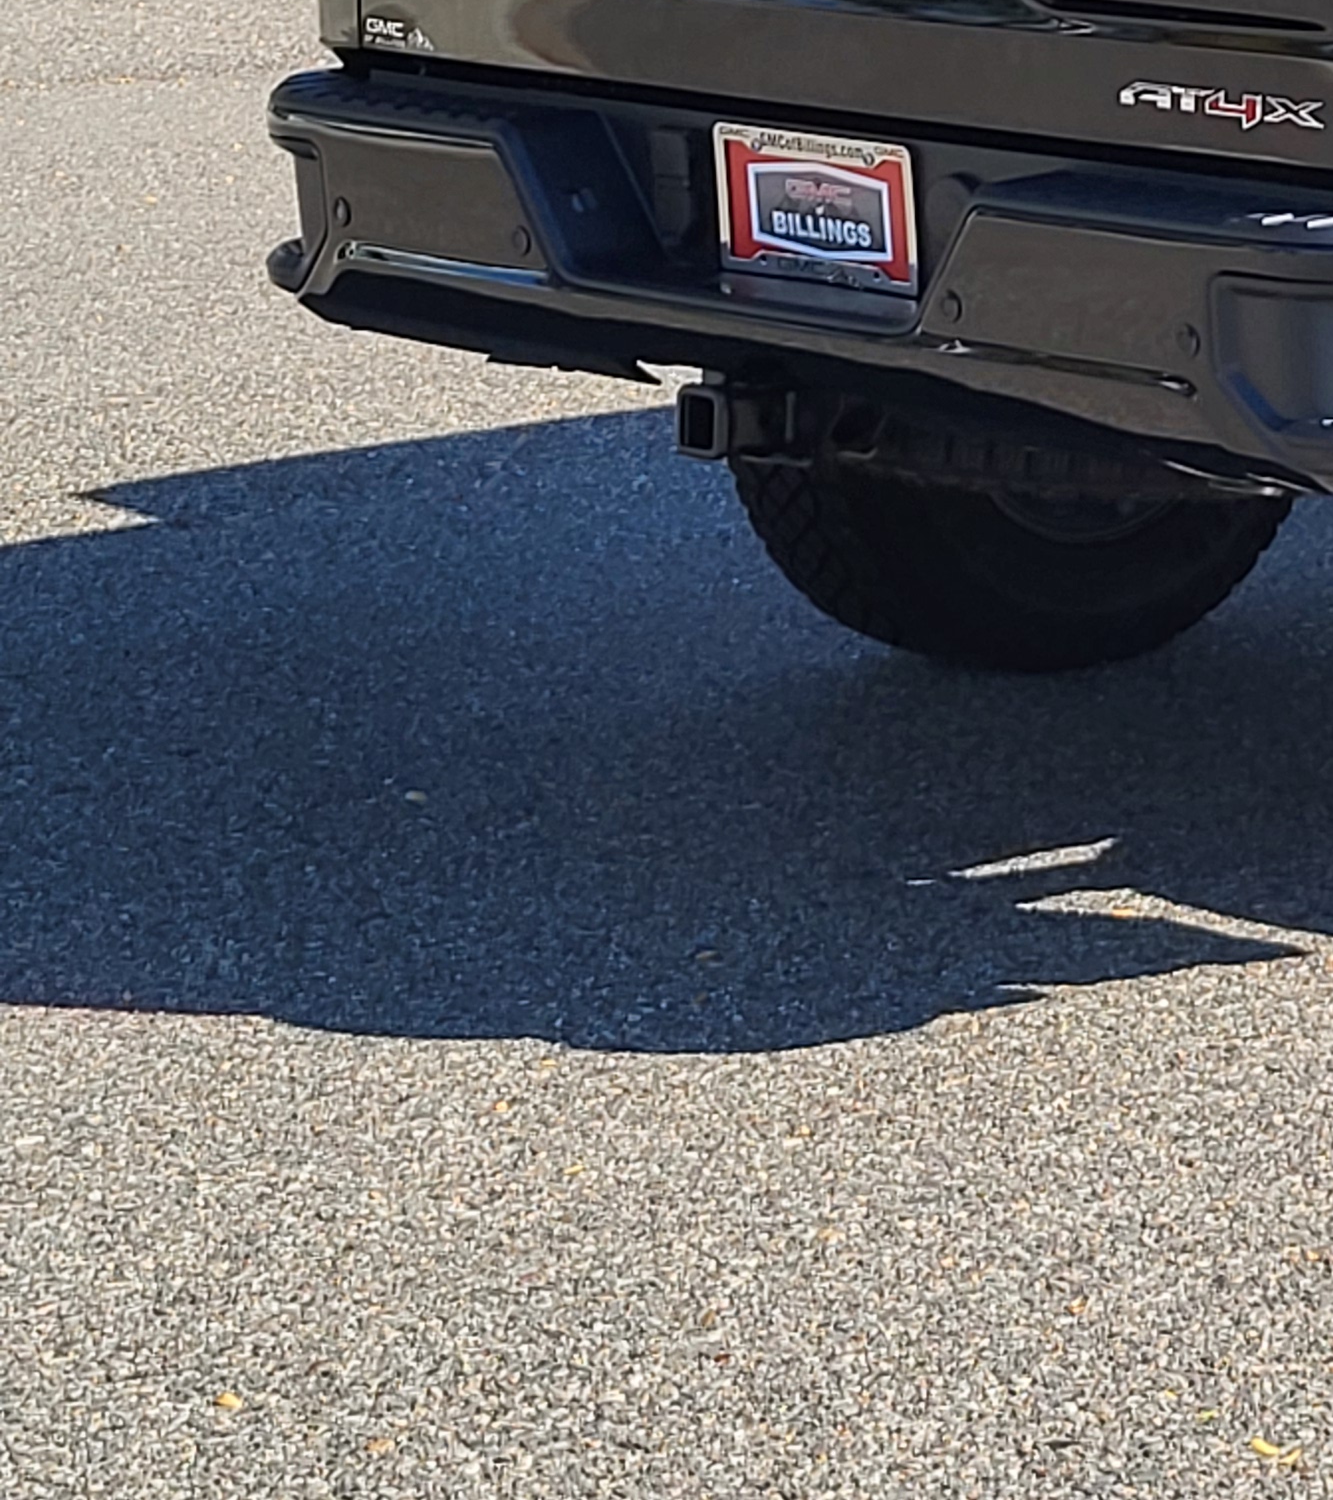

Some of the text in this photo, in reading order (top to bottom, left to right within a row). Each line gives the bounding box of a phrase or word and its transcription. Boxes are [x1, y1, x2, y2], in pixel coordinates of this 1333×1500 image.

[366, 17, 404, 38] GMC
[1119, 81, 1325, 130] AT4X
[785, 178, 852, 206] GMC
[771, 210, 873, 248] BILLINGS
